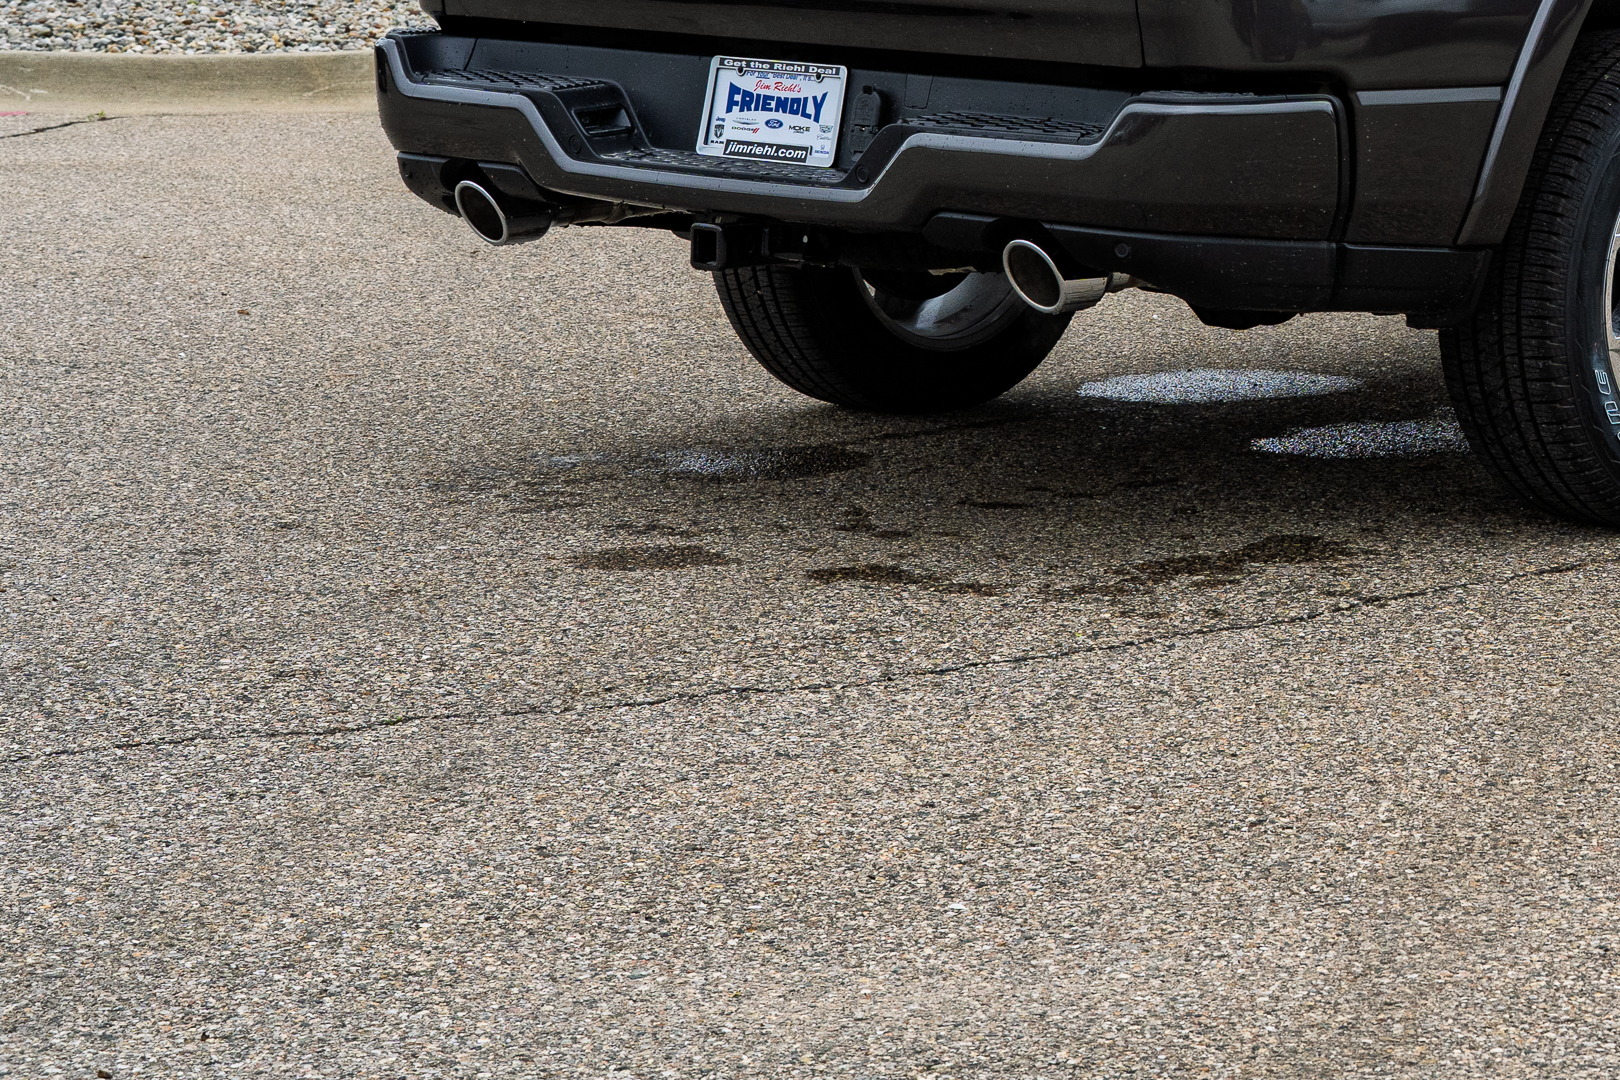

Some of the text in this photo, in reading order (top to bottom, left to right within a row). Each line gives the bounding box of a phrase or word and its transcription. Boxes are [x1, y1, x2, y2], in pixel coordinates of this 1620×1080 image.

[724, 59, 836, 75] Get the Riehl Deal
[754, 80, 802, 93] Jim Riehl's
[725, 81, 829, 124] FRIENDLY
[725, 141, 807, 159] jimriehl.com
